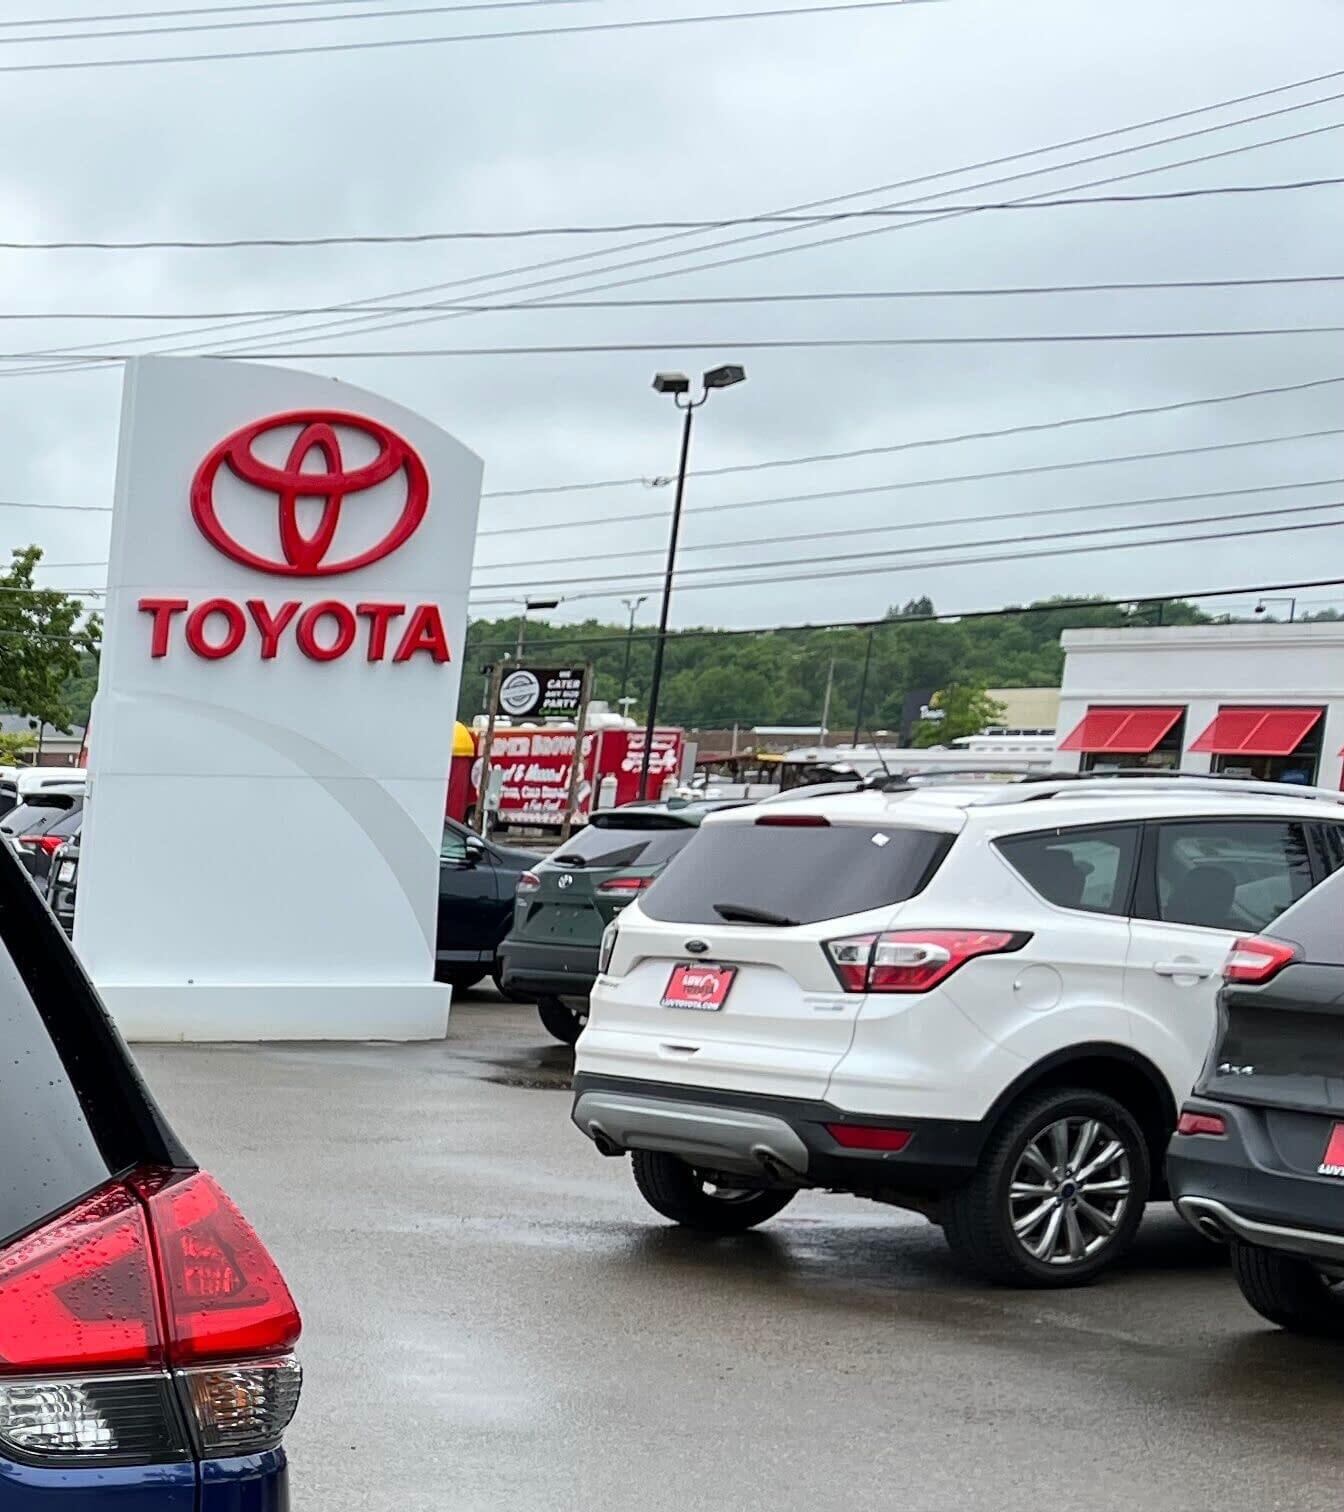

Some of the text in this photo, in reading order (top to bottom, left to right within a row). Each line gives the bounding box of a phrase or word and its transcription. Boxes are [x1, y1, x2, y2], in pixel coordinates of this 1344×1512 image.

[138, 598, 450, 663] TOYOTA
[547, 679, 581, 689] CATER
[542, 698, 577, 708] PARTY
